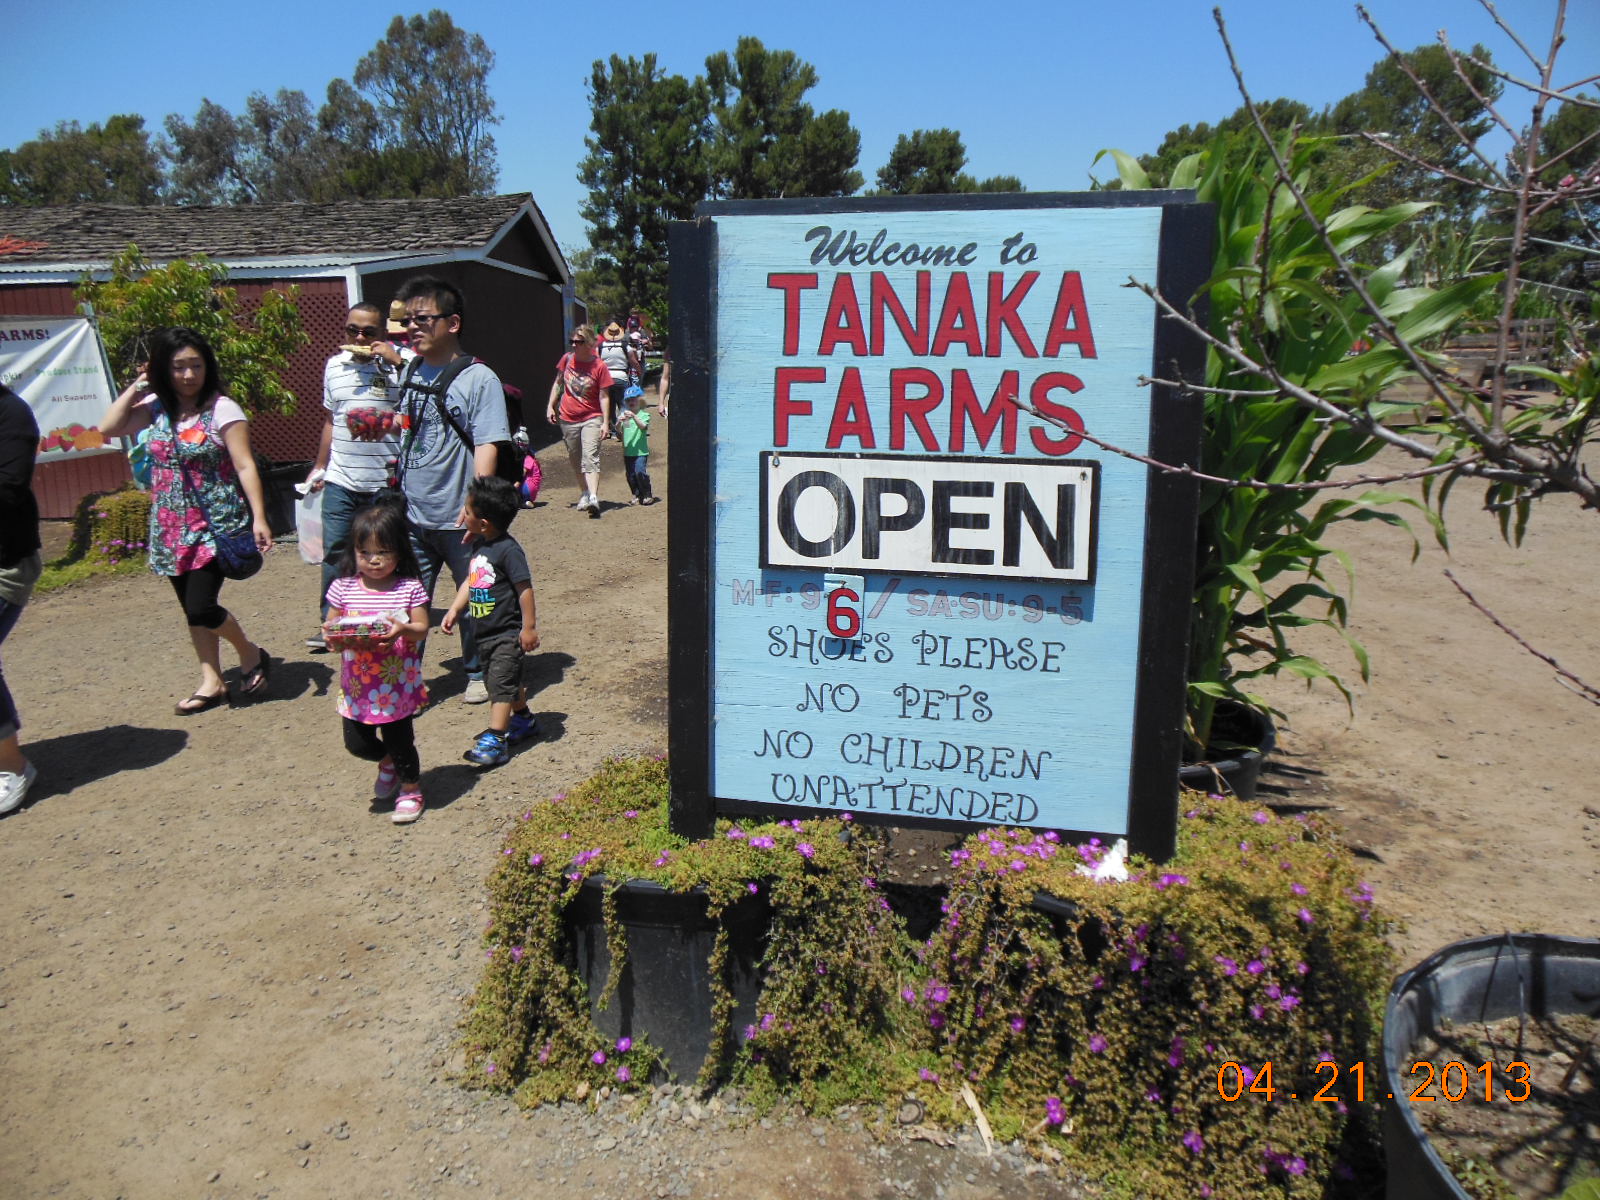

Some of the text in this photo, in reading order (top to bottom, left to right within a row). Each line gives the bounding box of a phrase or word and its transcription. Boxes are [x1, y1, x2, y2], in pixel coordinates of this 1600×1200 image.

[804, 225, 1039, 267] Welcome to
[766, 270, 1098, 359] TANAKA
[772, 366, 1086, 456] FARMS
[776, 470, 1077, 570] OPEN
[767, 624, 1067, 673] SHOES PLEASE
[796, 681, 994, 723] NO PETS
[754, 728, 1053, 782] NO CHILDREN
[770, 772, 1040, 823] UNATTENDED
